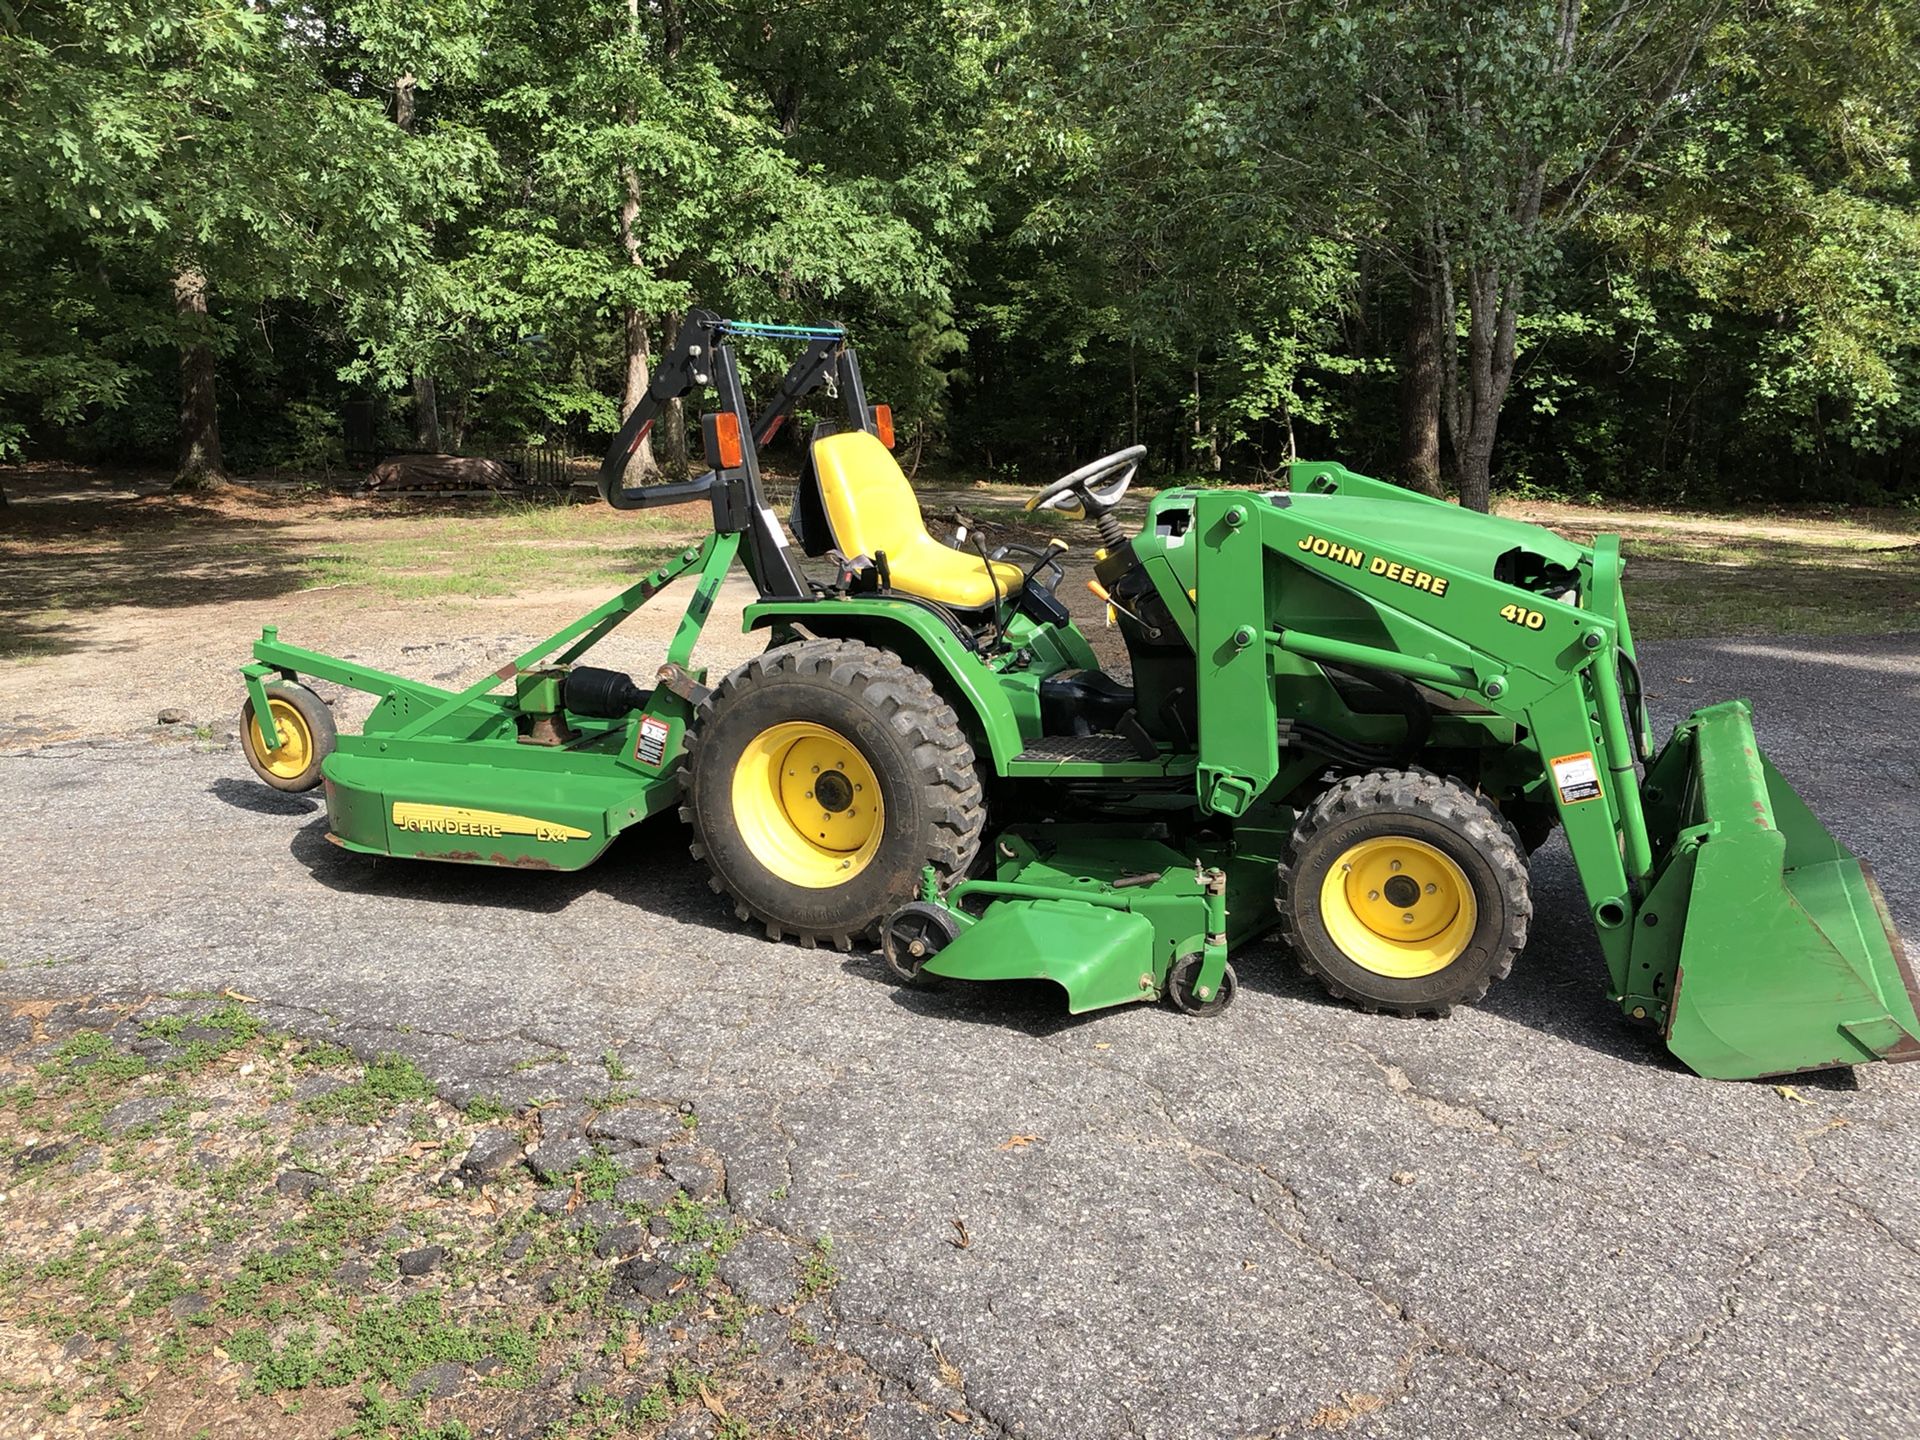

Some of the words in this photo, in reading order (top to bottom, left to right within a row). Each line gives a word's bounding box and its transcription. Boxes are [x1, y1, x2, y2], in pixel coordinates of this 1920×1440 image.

[1298, 535, 1364, 569] JOHN
[1369, 556, 1449, 597] DEERE
[1500, 603, 1545, 631] 410
[399, 816, 444, 834] JOHN
[445, 819, 502, 838] DEERE
[536, 828, 568, 843] LX4
